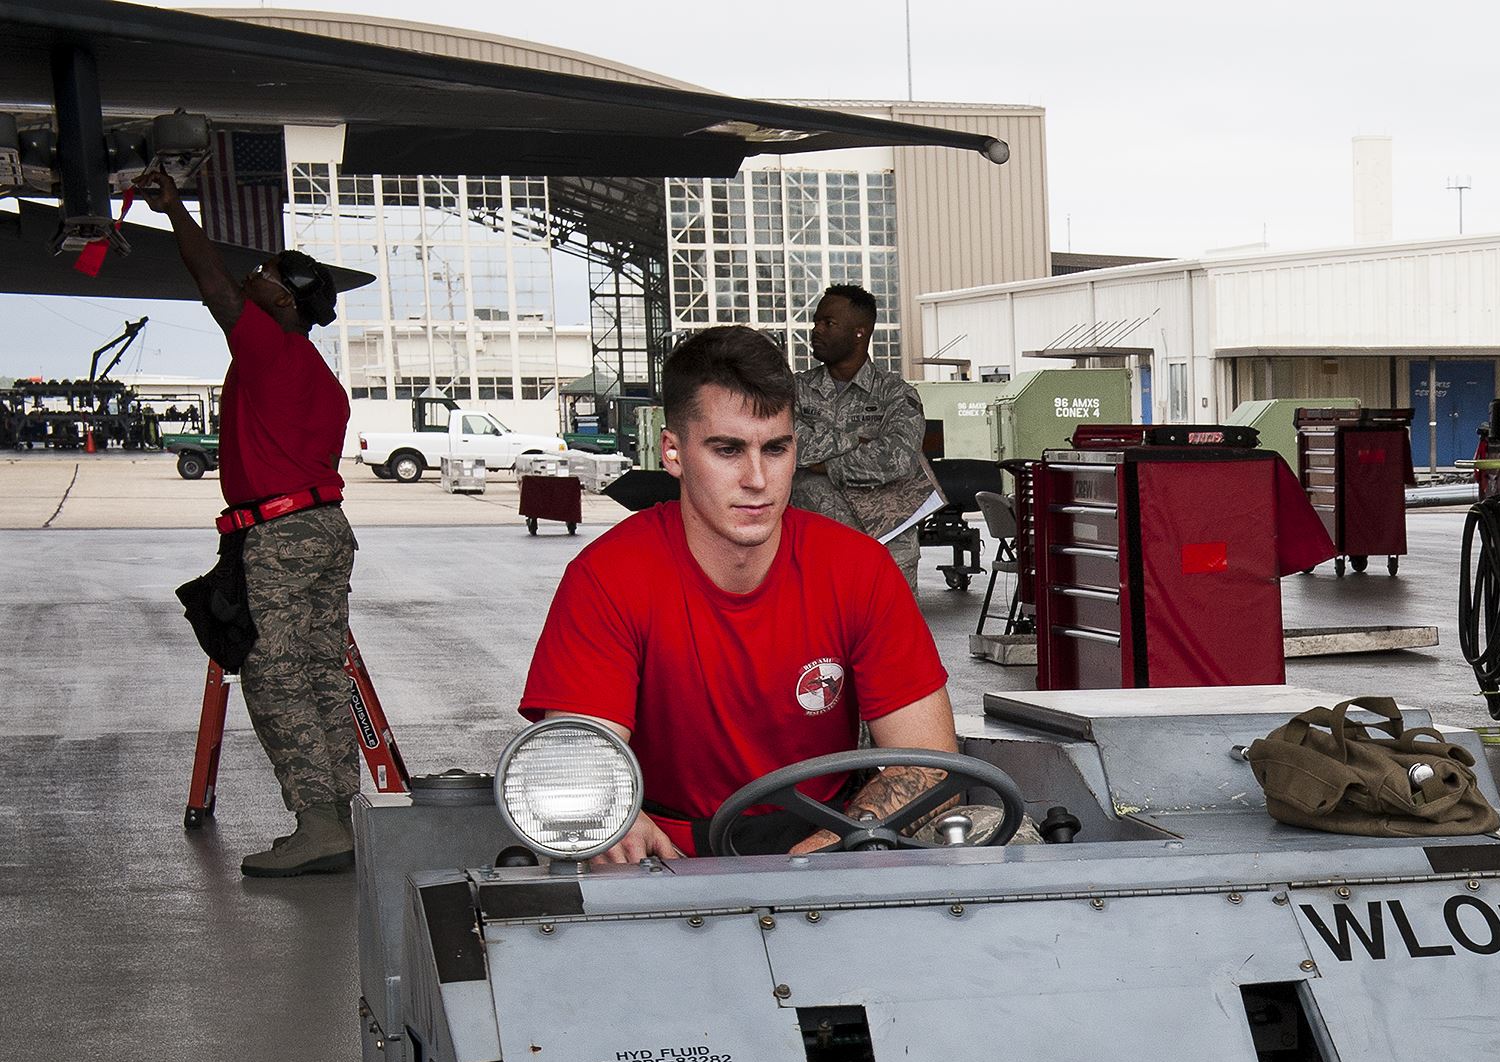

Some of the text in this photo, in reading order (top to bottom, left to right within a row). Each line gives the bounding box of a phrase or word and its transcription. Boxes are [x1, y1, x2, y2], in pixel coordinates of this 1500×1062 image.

[1054, 397, 1100, 408] 96 AMXS
[1055, 407, 1100, 418] CONEX 4
[616, 1046, 710, 1061] HYD FLUID
